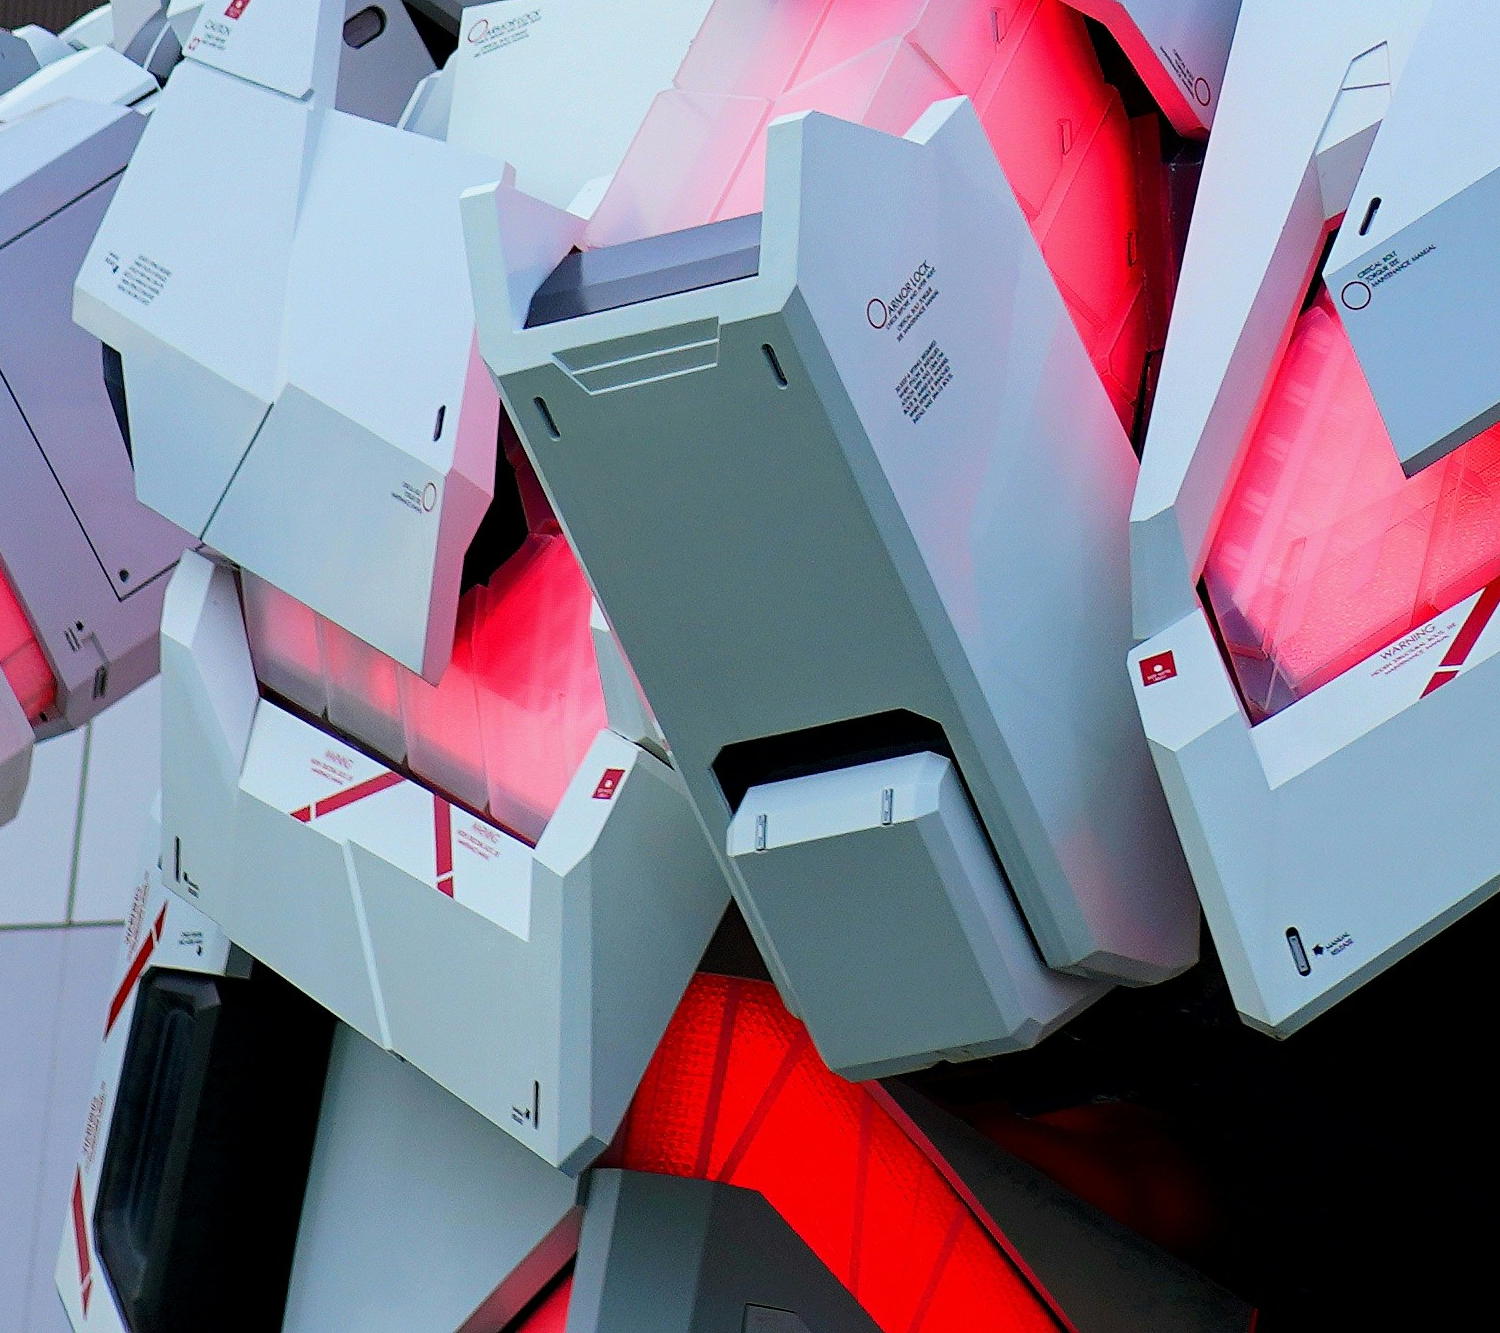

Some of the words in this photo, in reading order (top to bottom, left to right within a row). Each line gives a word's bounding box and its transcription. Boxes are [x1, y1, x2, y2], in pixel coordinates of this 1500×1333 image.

[887, 281, 913, 316] ARMOR
[909, 259, 930, 288] LOCK
[1380, 623, 1436, 661] WARNING
